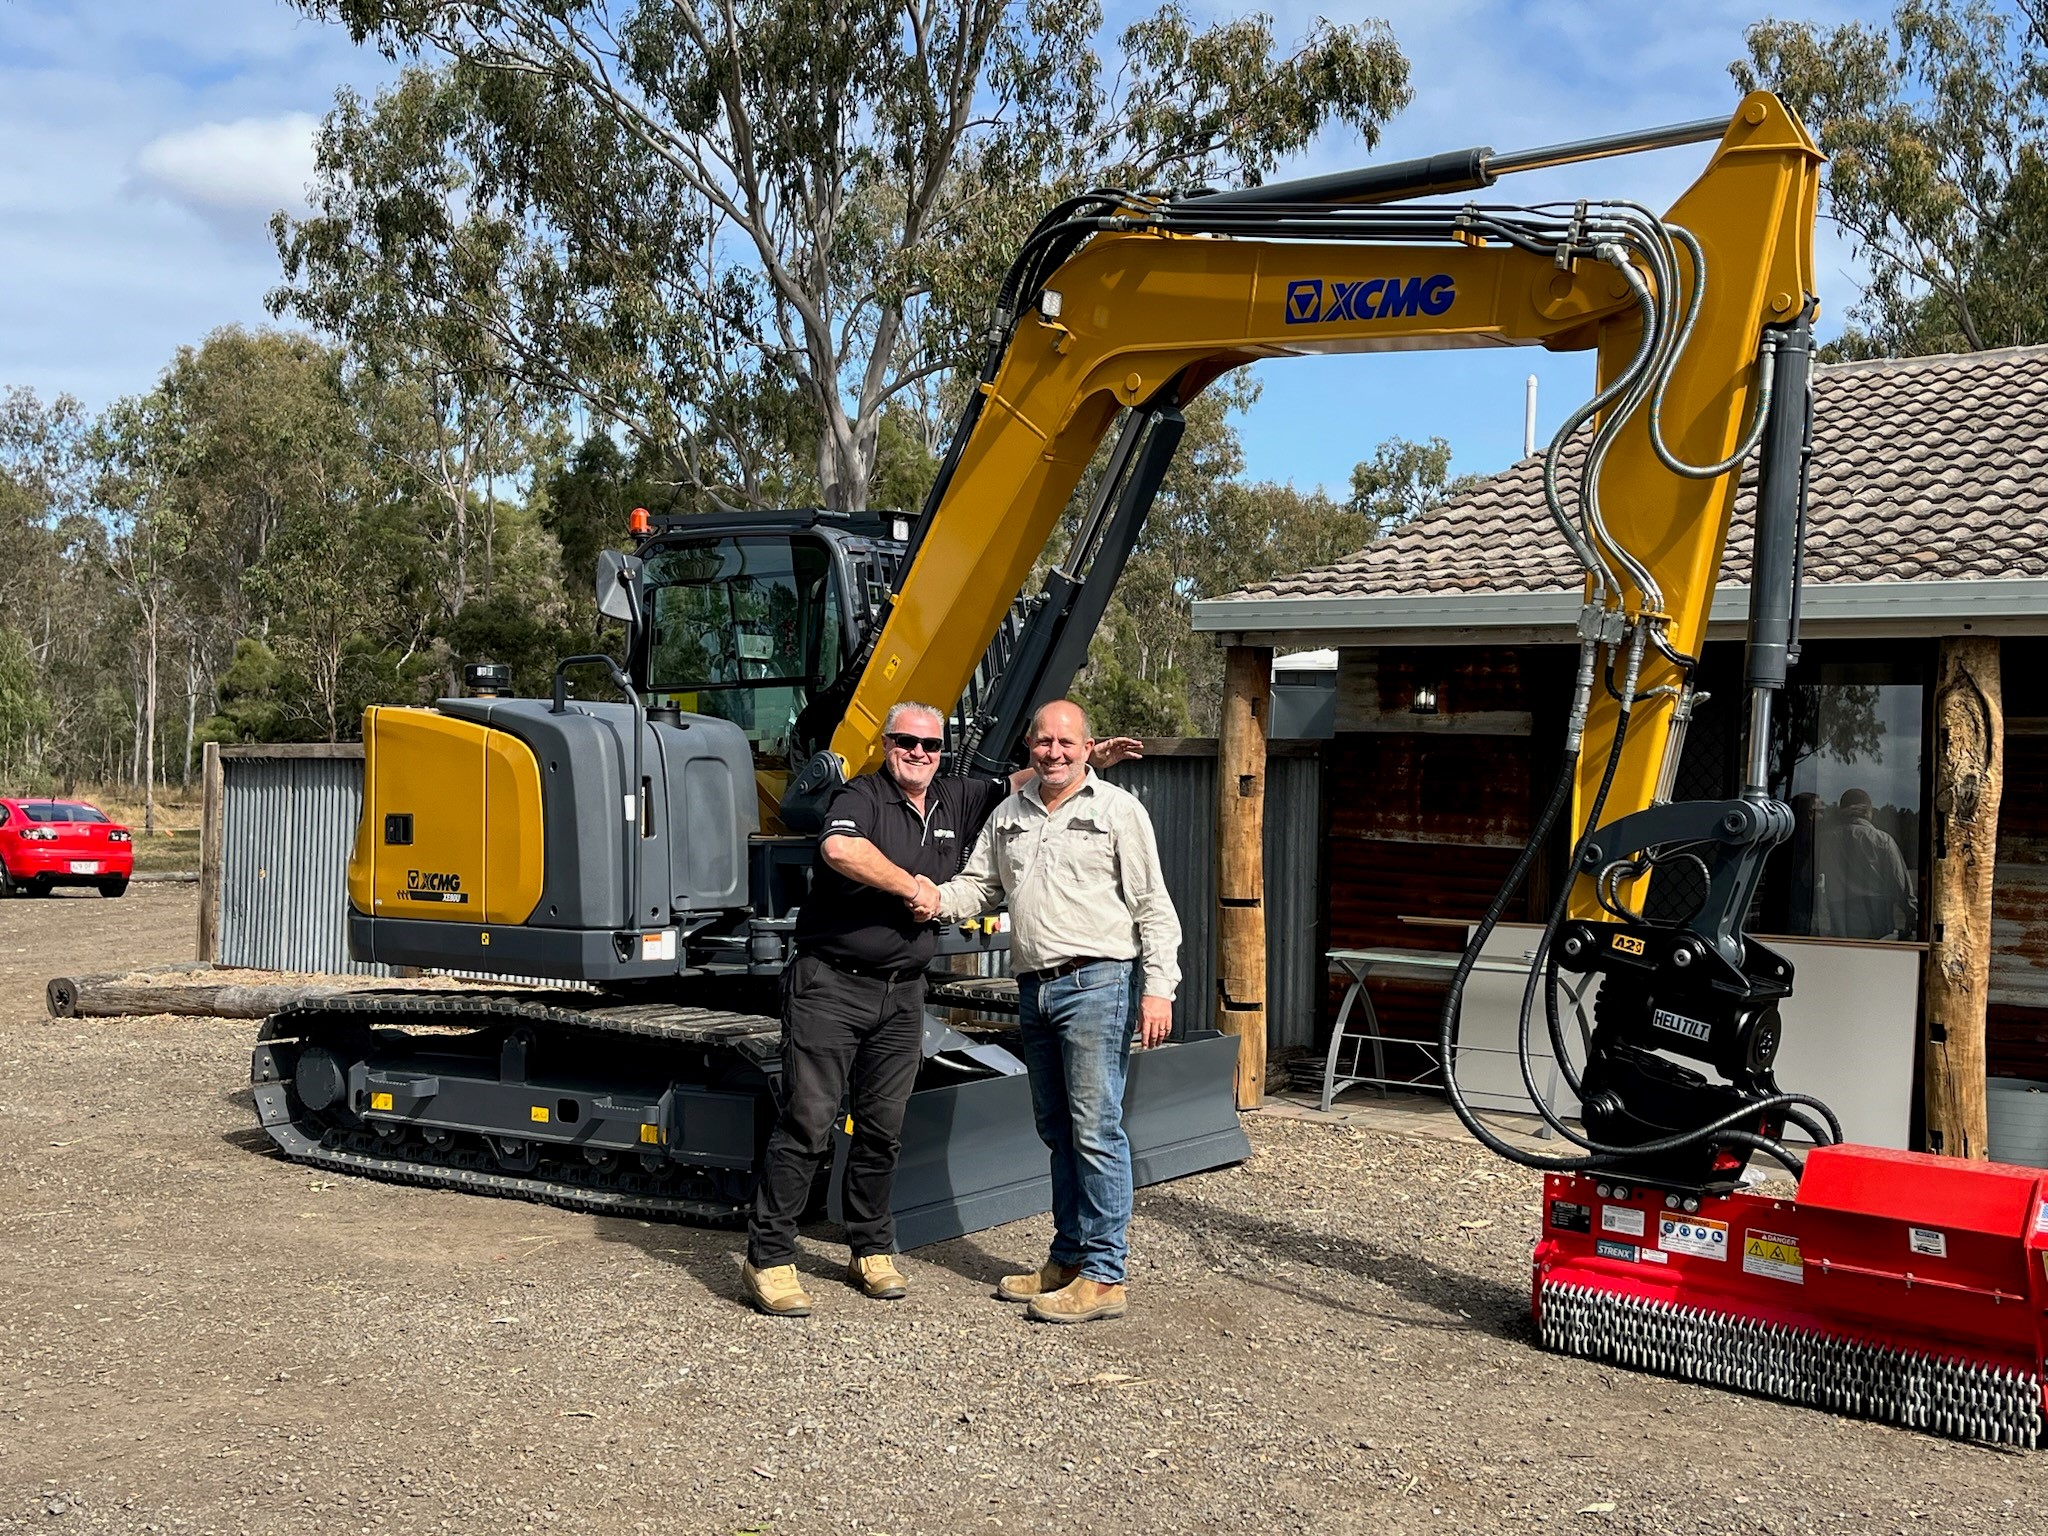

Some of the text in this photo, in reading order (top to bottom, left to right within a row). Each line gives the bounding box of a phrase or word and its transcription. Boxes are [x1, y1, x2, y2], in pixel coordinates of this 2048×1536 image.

[1320, 274, 1456, 322] XCMG
[420, 872, 461, 892] XCMG
[1767, 1234, 1797, 1246] DANGER
[1597, 1245, 1630, 1259] STRENX
